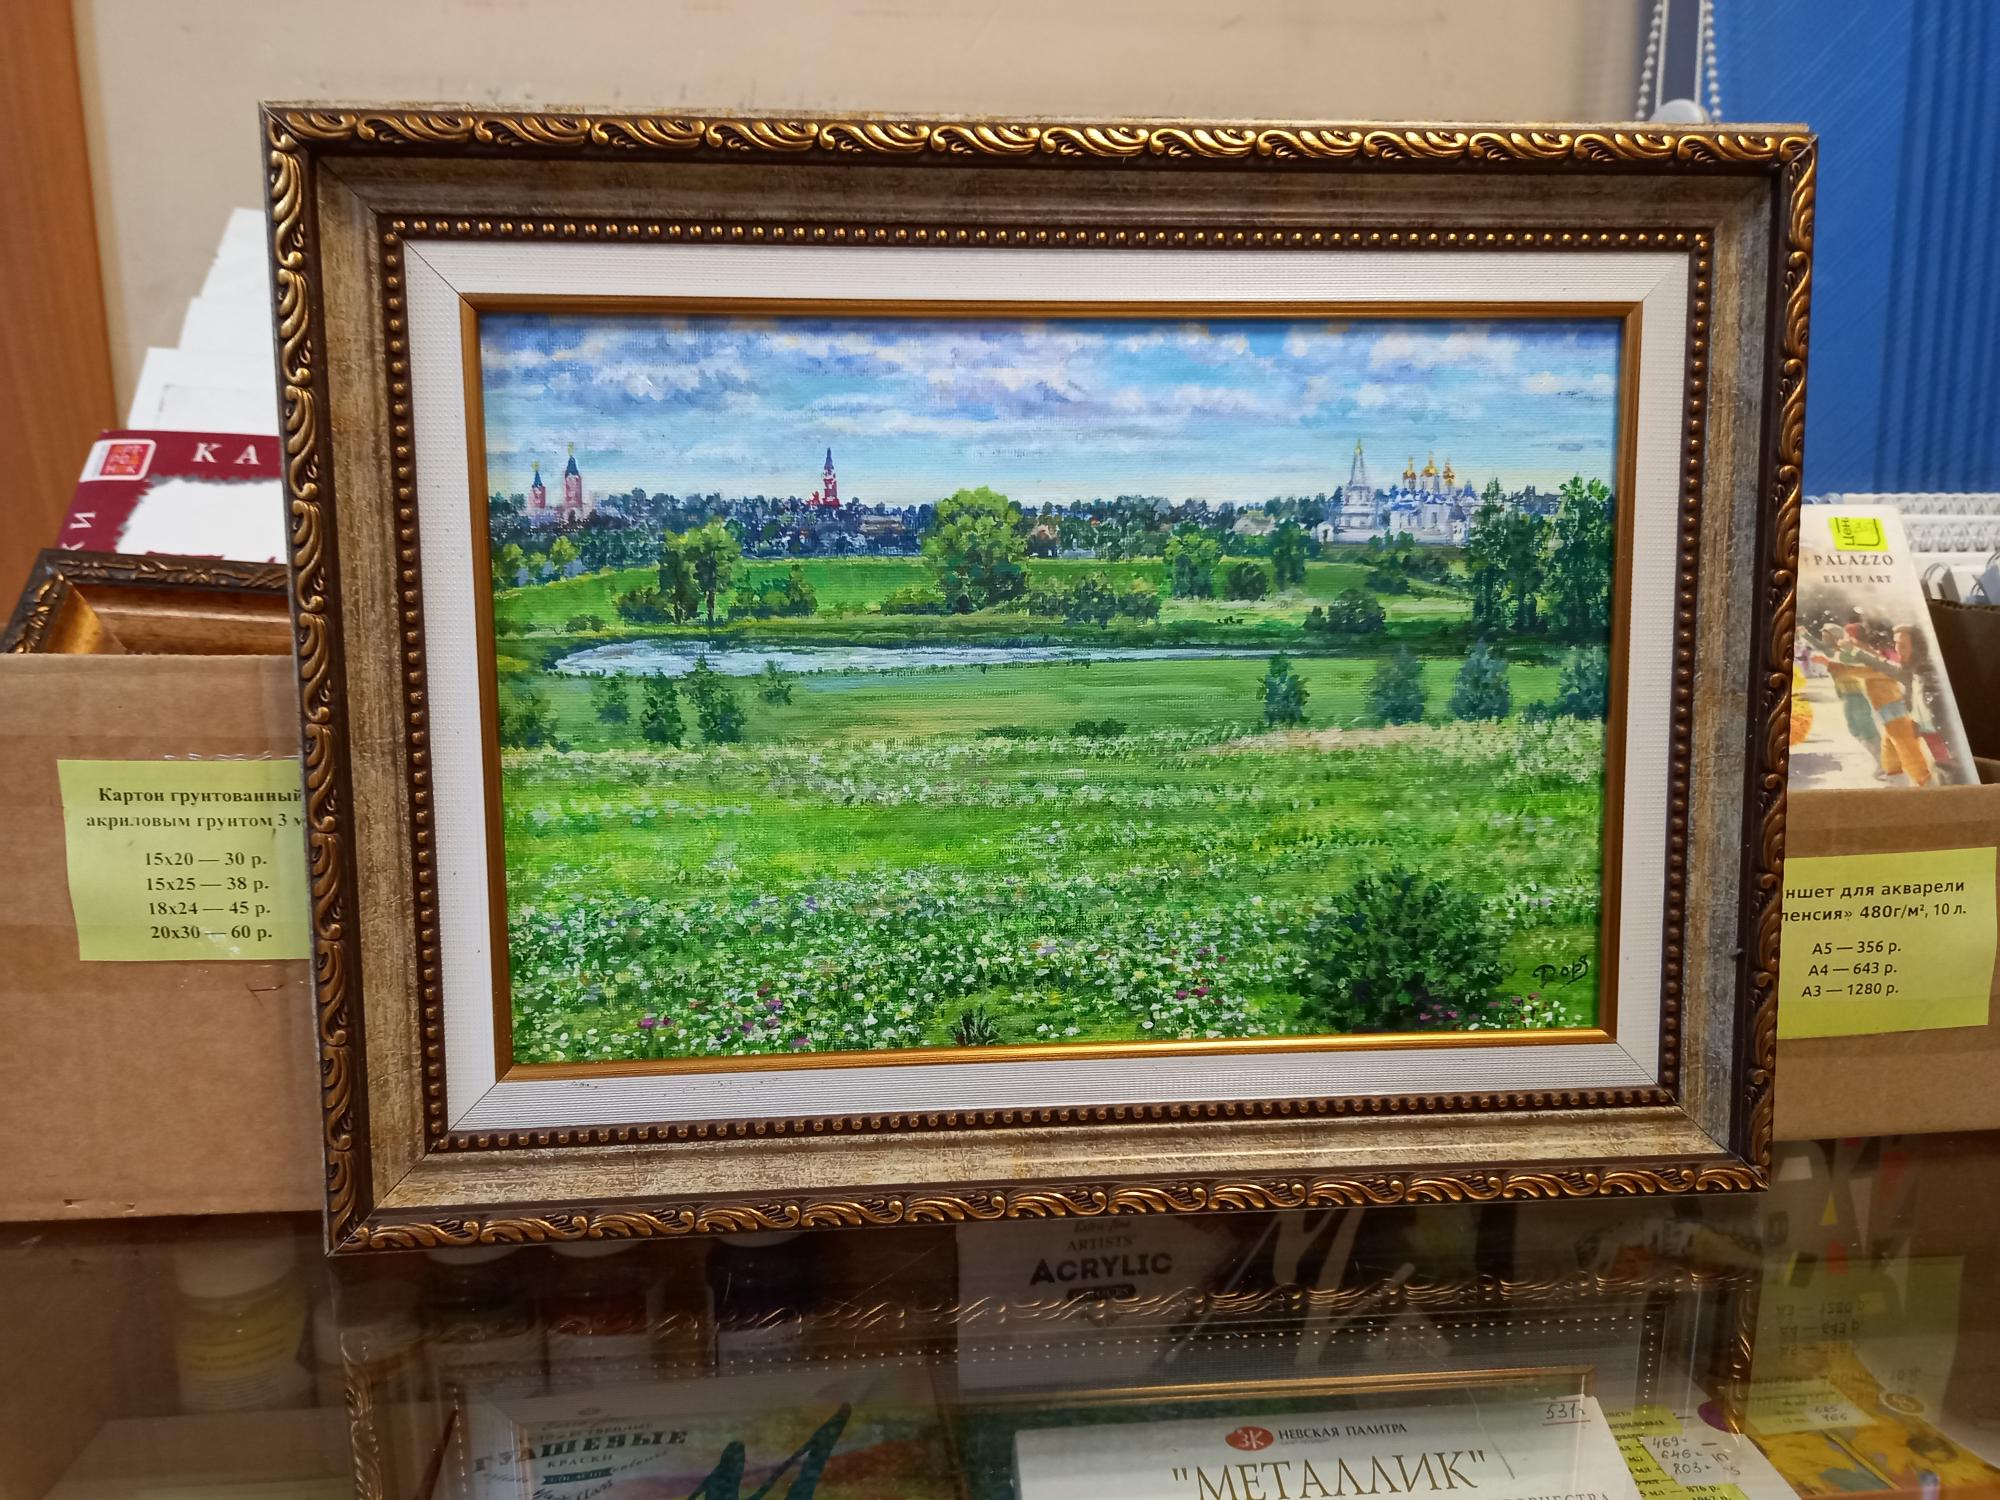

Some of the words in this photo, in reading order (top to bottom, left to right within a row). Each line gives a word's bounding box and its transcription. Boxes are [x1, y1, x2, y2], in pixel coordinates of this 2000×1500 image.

[1814, 553, 1894, 567] PALAZZO
[1823, 574, 1864, 584] ELITE
[1867, 574, 1893, 584] ART
[98, 787, 165, 805] Картон
[170, 787, 302, 806] грунтованный
[85, 815, 191, 831] акриловым
[196, 815, 273, 831] грунтом
[277, 813, 288, 827] 3
[223, 851, 246, 866] 30
[251, 854, 268, 869] р.
[226, 876, 248, 891] 38
[253, 879, 270, 894] р.
[1839, 884, 1875, 899] для
[1880, 881, 1965, 897] акварели
[228, 900, 250, 915] 45
[255, 903, 271, 918] р.
[1933, 903, 1950, 916] 10
[1952, 903, 1967, 916] л.
[230, 925, 251, 939] 60
[256, 928, 273, 942] р.
[1812, 941, 1832, 955] A5
[1857, 940, 1884, 954] 356
[1888, 942, 1902, 956] р.
[1808, 963, 1829, 977] A4
[1853, 962, 1880, 975] 643
[1884, 963, 1897, 978] р.
[1801, 984, 1822, 998] A3
[1847, 982, 1882, 996] 1280
[1886, 984, 1899, 999] р.
[1029, 1252, 1173, 1286] ACRYLIC
[1277, 1426, 1340, 1441] НЕВСКАЯ
[1346, 1422, 1408, 1437] ПАЛИТРА
[547, 1453, 613, 1469] КРАСКИ
